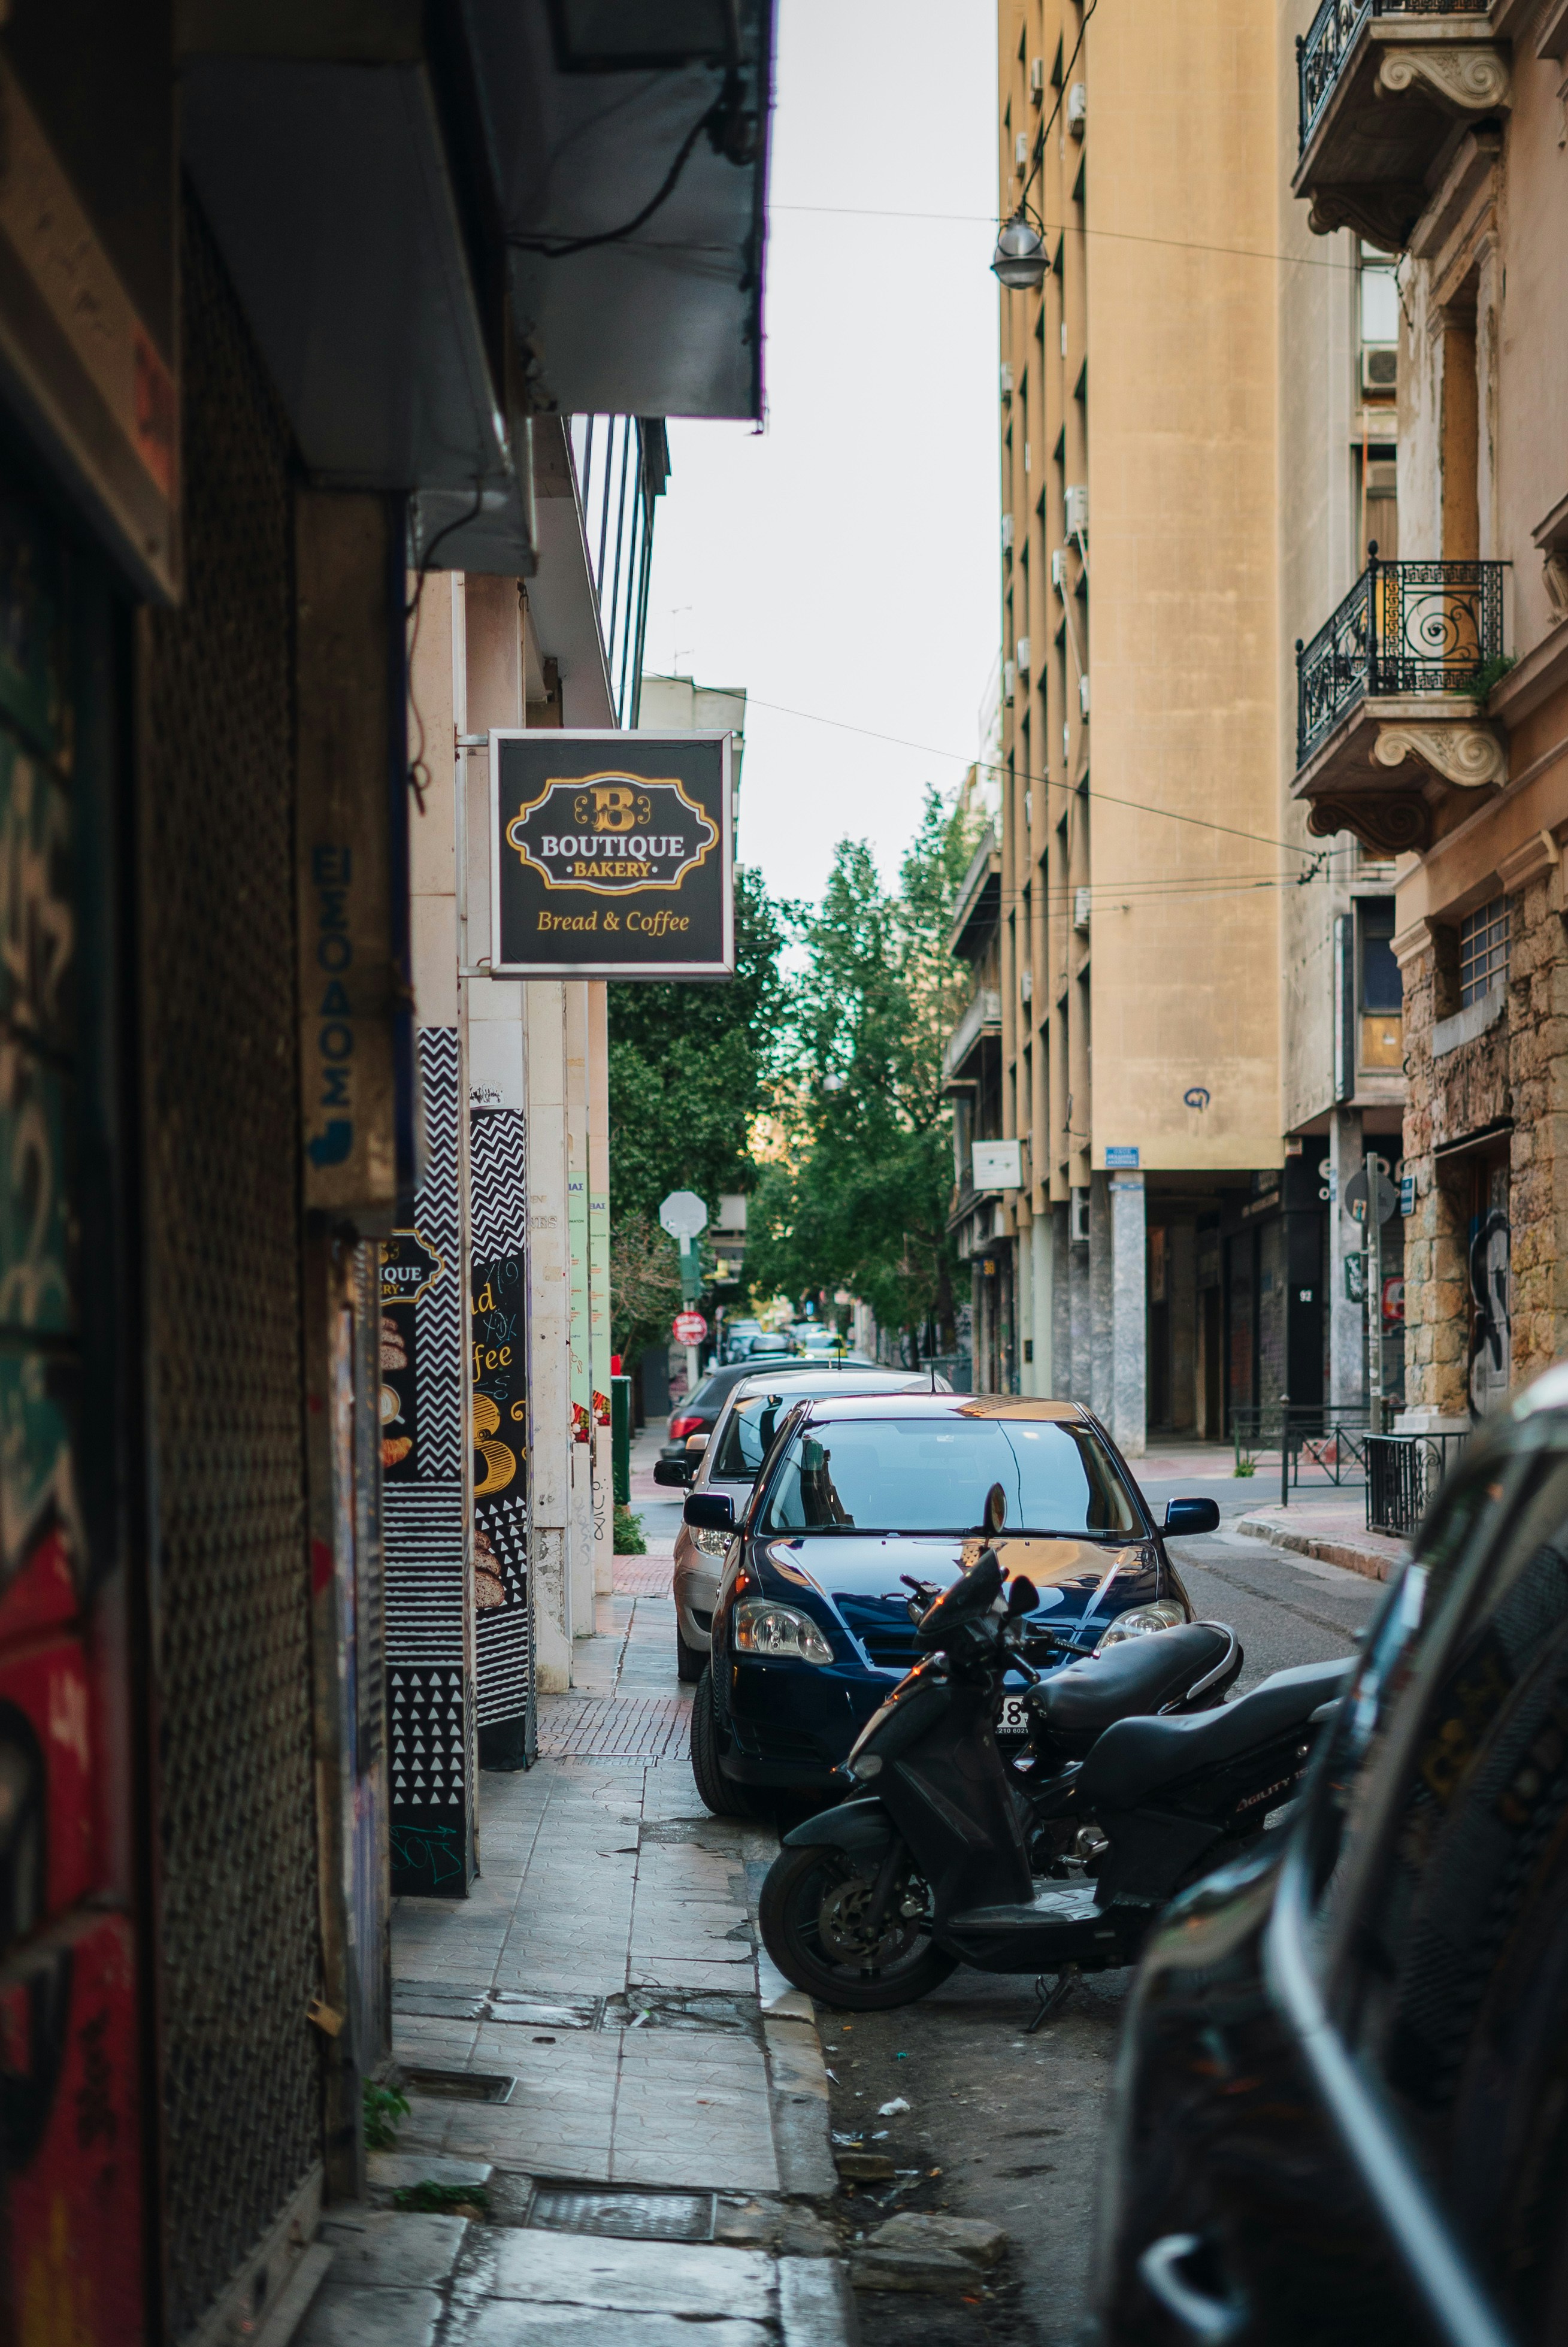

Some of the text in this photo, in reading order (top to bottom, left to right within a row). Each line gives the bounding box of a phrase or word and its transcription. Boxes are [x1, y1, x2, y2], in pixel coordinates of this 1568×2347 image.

[541, 835, 685, 862] BOUTIQUE
[574, 861, 652, 877] BAKERY
[537, 911, 689, 936] Bread & Coffee
[1236, 1777, 1290, 1813] AGILITY
